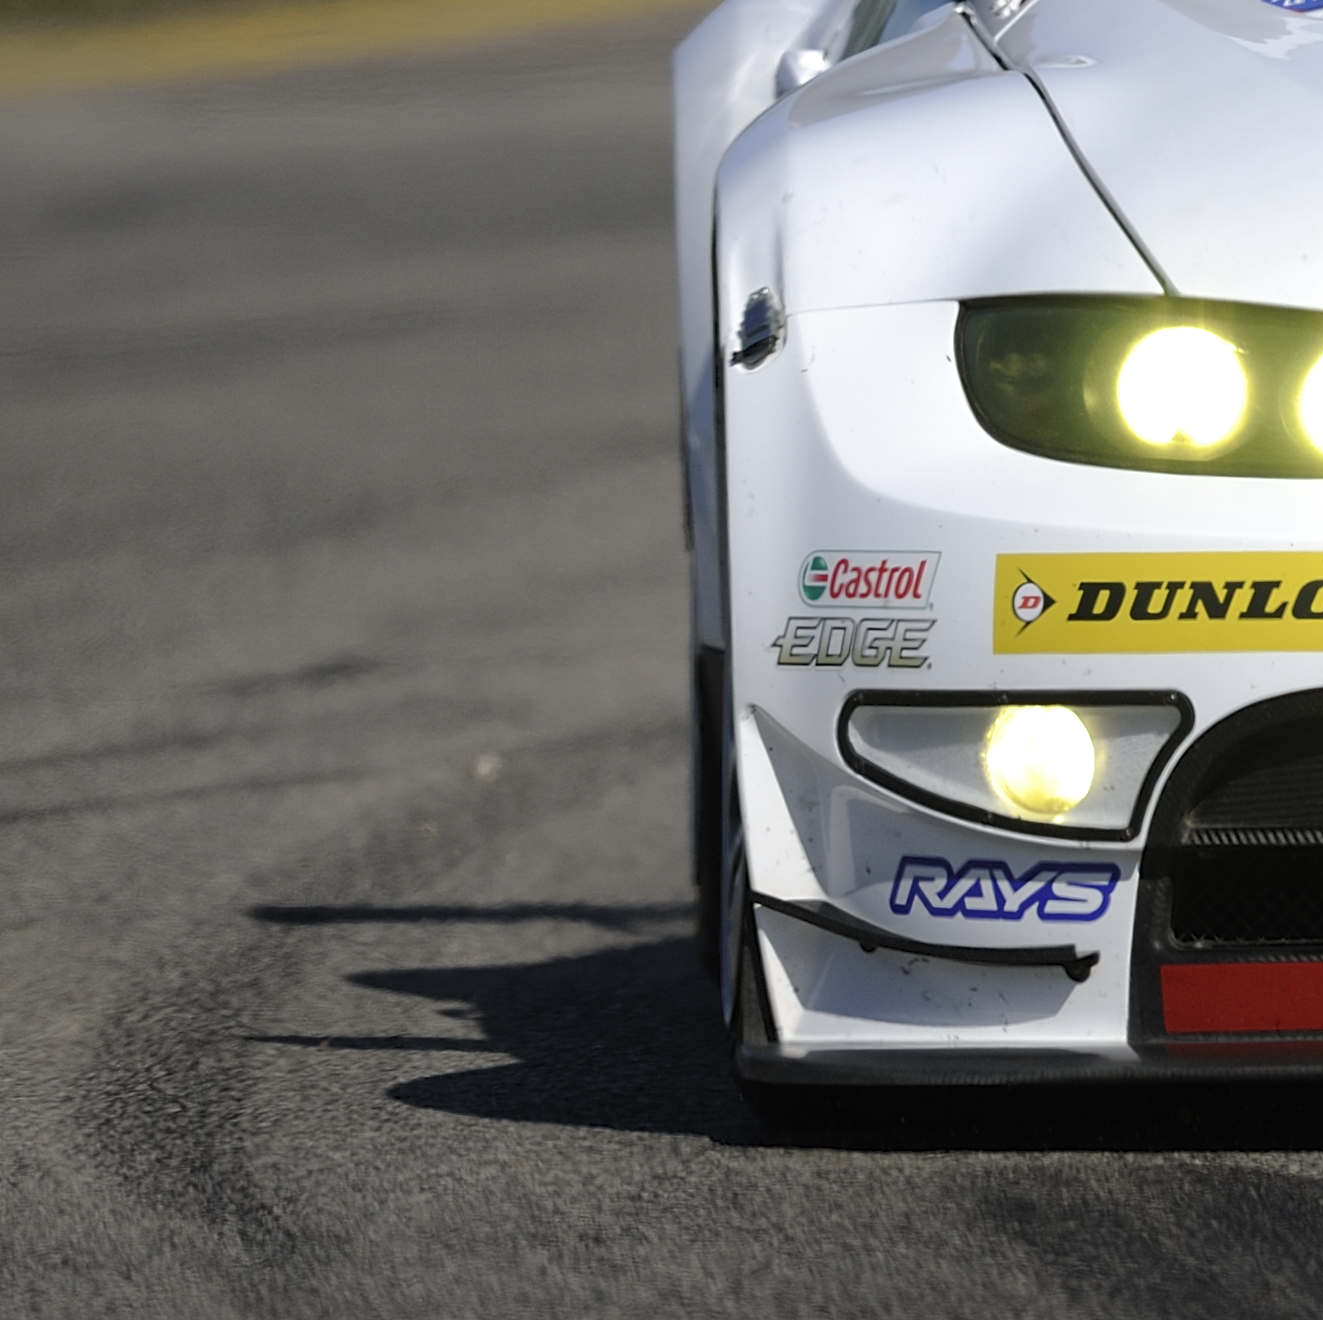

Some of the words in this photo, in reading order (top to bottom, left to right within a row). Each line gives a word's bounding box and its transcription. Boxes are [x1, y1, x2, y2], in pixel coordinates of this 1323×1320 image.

[828, 556, 927, 602] Castrol
[771, 616, 937, 668] EDGE
[889, 855, 1122, 922] RAYS
